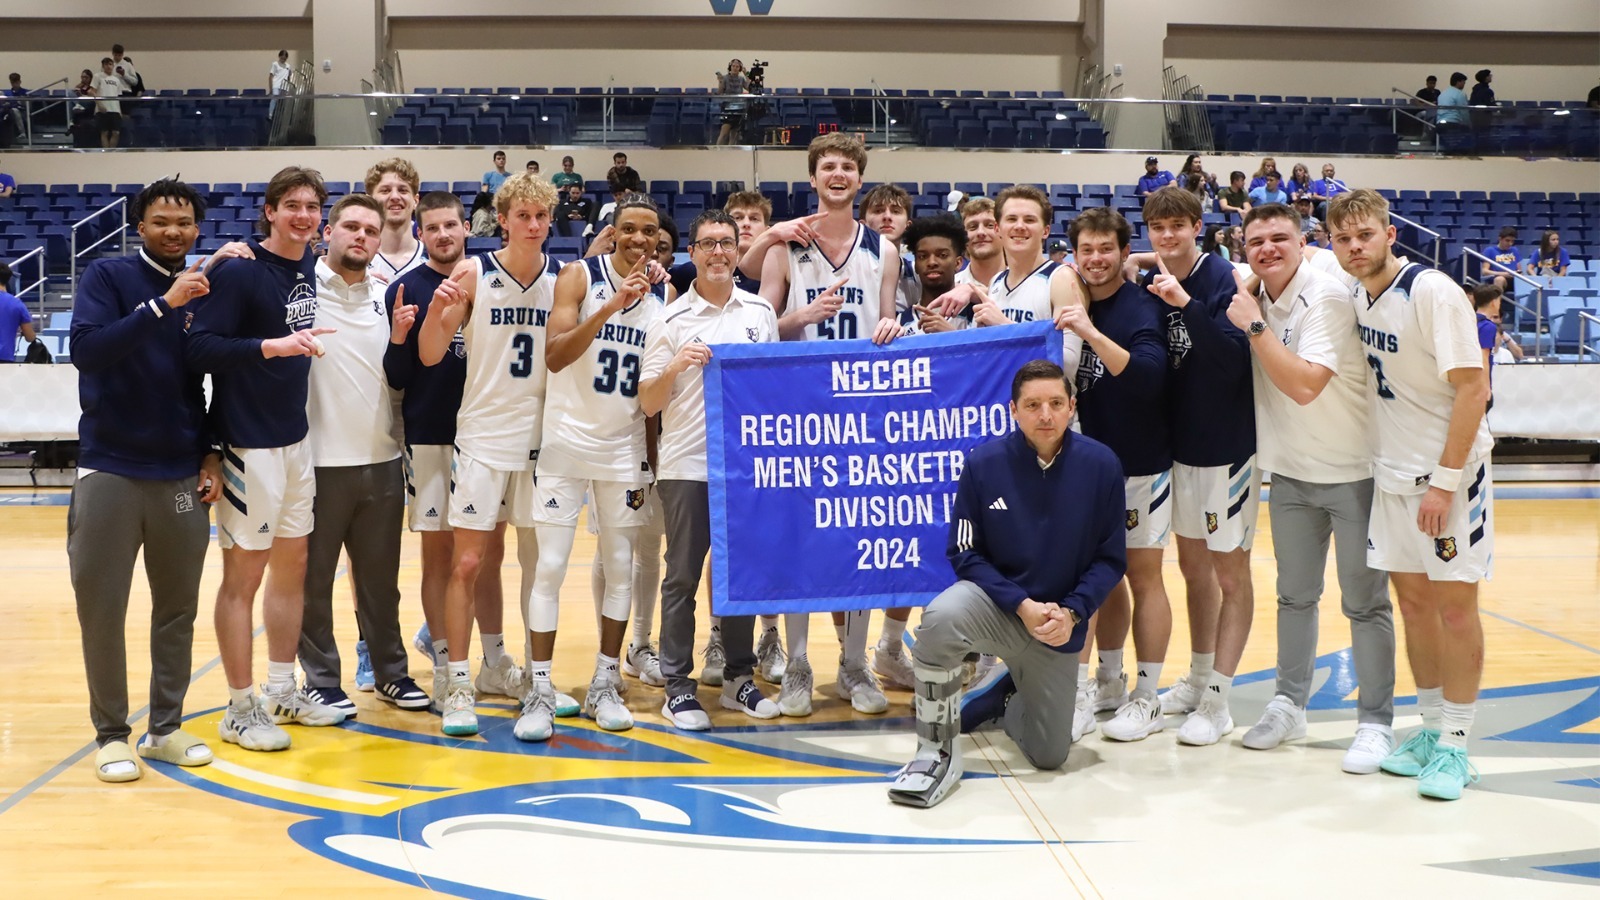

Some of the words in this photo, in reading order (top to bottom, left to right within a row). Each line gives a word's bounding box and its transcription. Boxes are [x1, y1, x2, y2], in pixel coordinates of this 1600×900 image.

[806, 286, 864, 305] BINS
[490, 306, 552, 327] BRUIN
[509, 332, 534, 379] 3
[593, 348, 641, 398] 33
[831, 356, 932, 392] NCCAA
[740, 412, 876, 446] REGIONAL
[884, 402, 1018, 444] CHAMPIO
[754, 454, 839, 488] MEN'S
[848, 449, 965, 486] BASKETB
[814, 493, 934, 528] DIVISION
[943, 492, 958, 524] I
[857, 537, 921, 570] 2024
